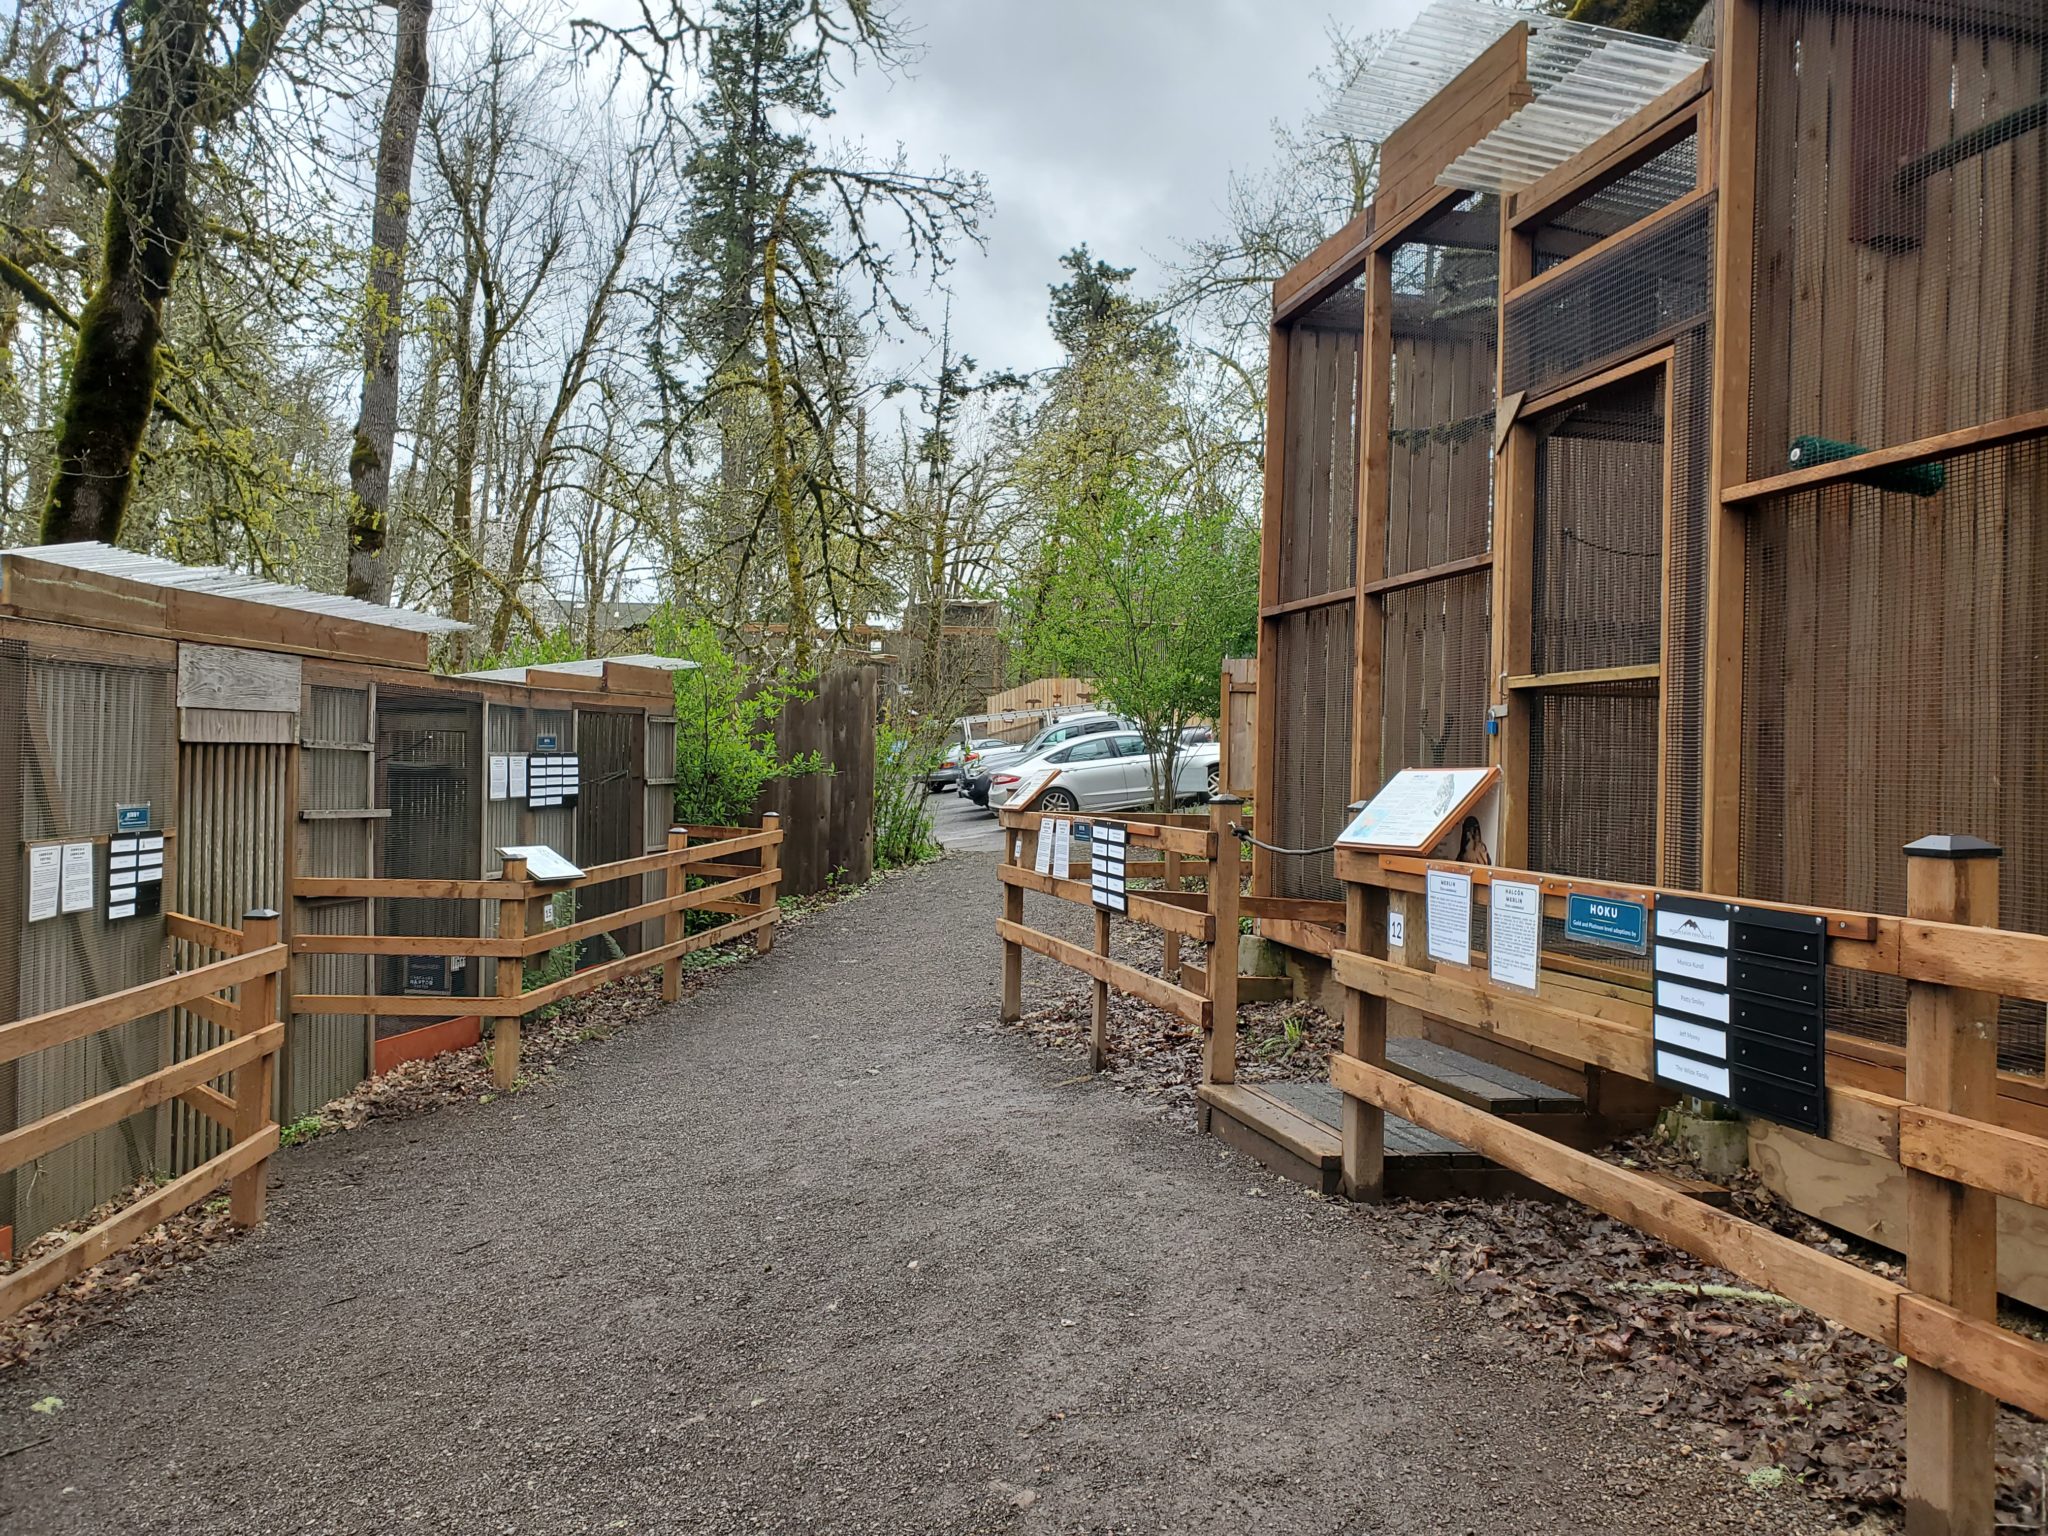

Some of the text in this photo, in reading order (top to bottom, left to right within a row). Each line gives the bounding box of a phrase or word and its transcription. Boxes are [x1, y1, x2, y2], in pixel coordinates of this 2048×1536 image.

[1505, 896, 1523, 904] MERLIN
[1590, 903, 1618, 918] HOKU
[1392, 921, 1402, 940] 12
[1588, 922, 1604, 931] Platinum
[1613, 928, 1632, 936] adoptions
[1631, 930, 1637, 938] by
